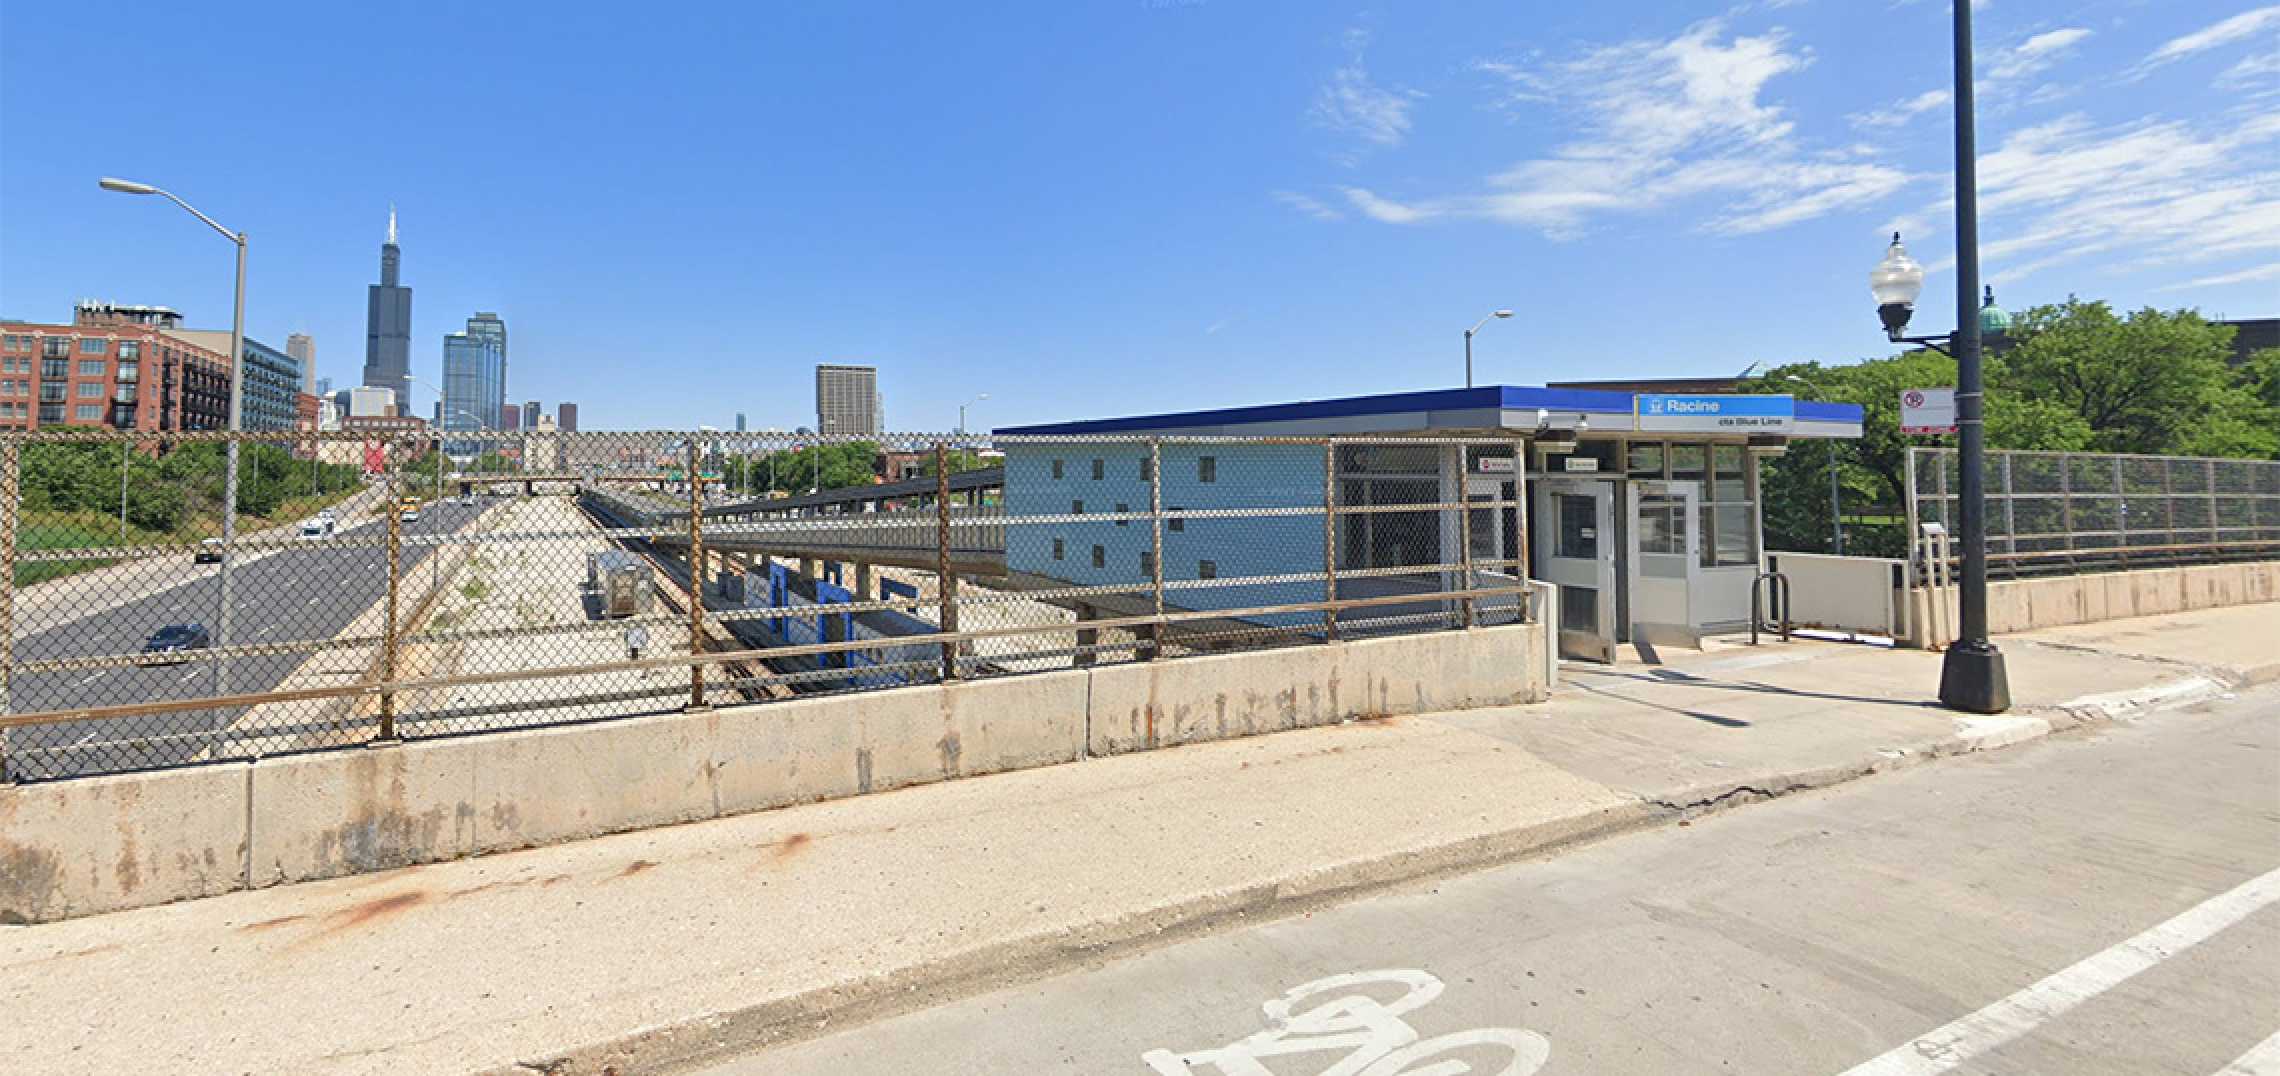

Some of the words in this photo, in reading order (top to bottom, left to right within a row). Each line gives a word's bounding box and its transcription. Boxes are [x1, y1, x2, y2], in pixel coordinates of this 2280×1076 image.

[1667, 399, 1720, 412] Racine
[1736, 417, 1759, 426] Blue
[1761, 417, 1783, 426] Line
